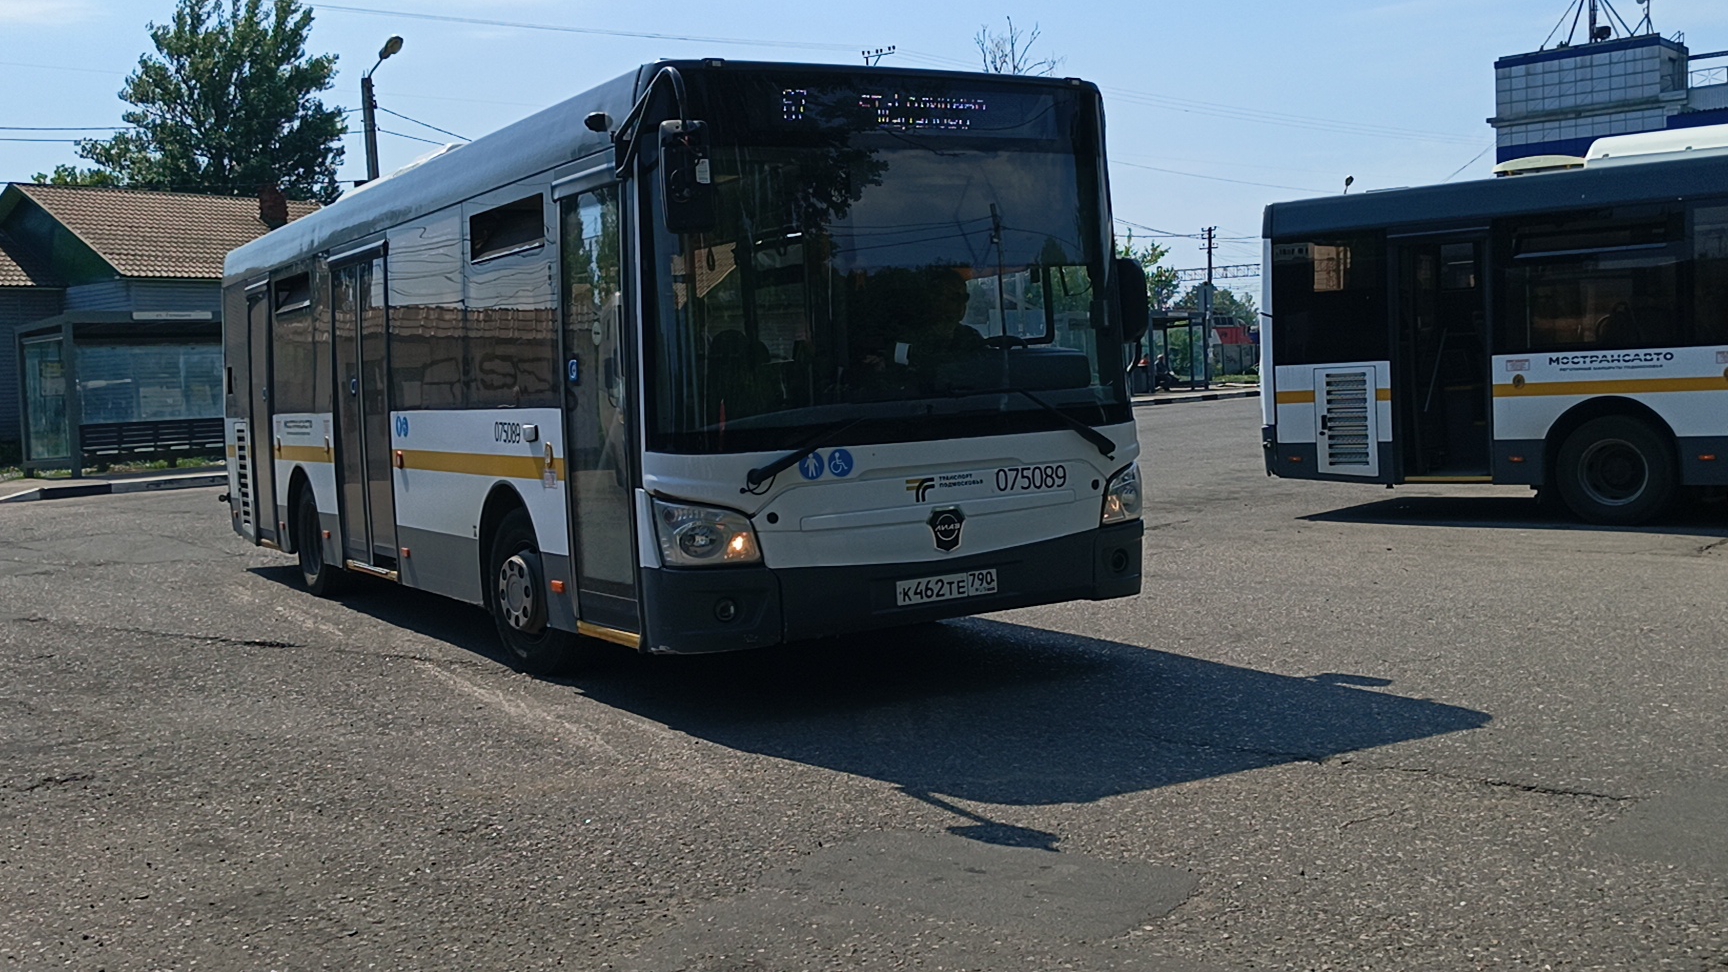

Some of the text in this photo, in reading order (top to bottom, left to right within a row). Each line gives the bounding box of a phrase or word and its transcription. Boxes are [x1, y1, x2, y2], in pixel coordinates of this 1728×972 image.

[1549, 351, 1674, 366] МОСТРАНСАВТО
[494, 421, 520, 444] 075089
[996, 464, 1067, 492] 075089
